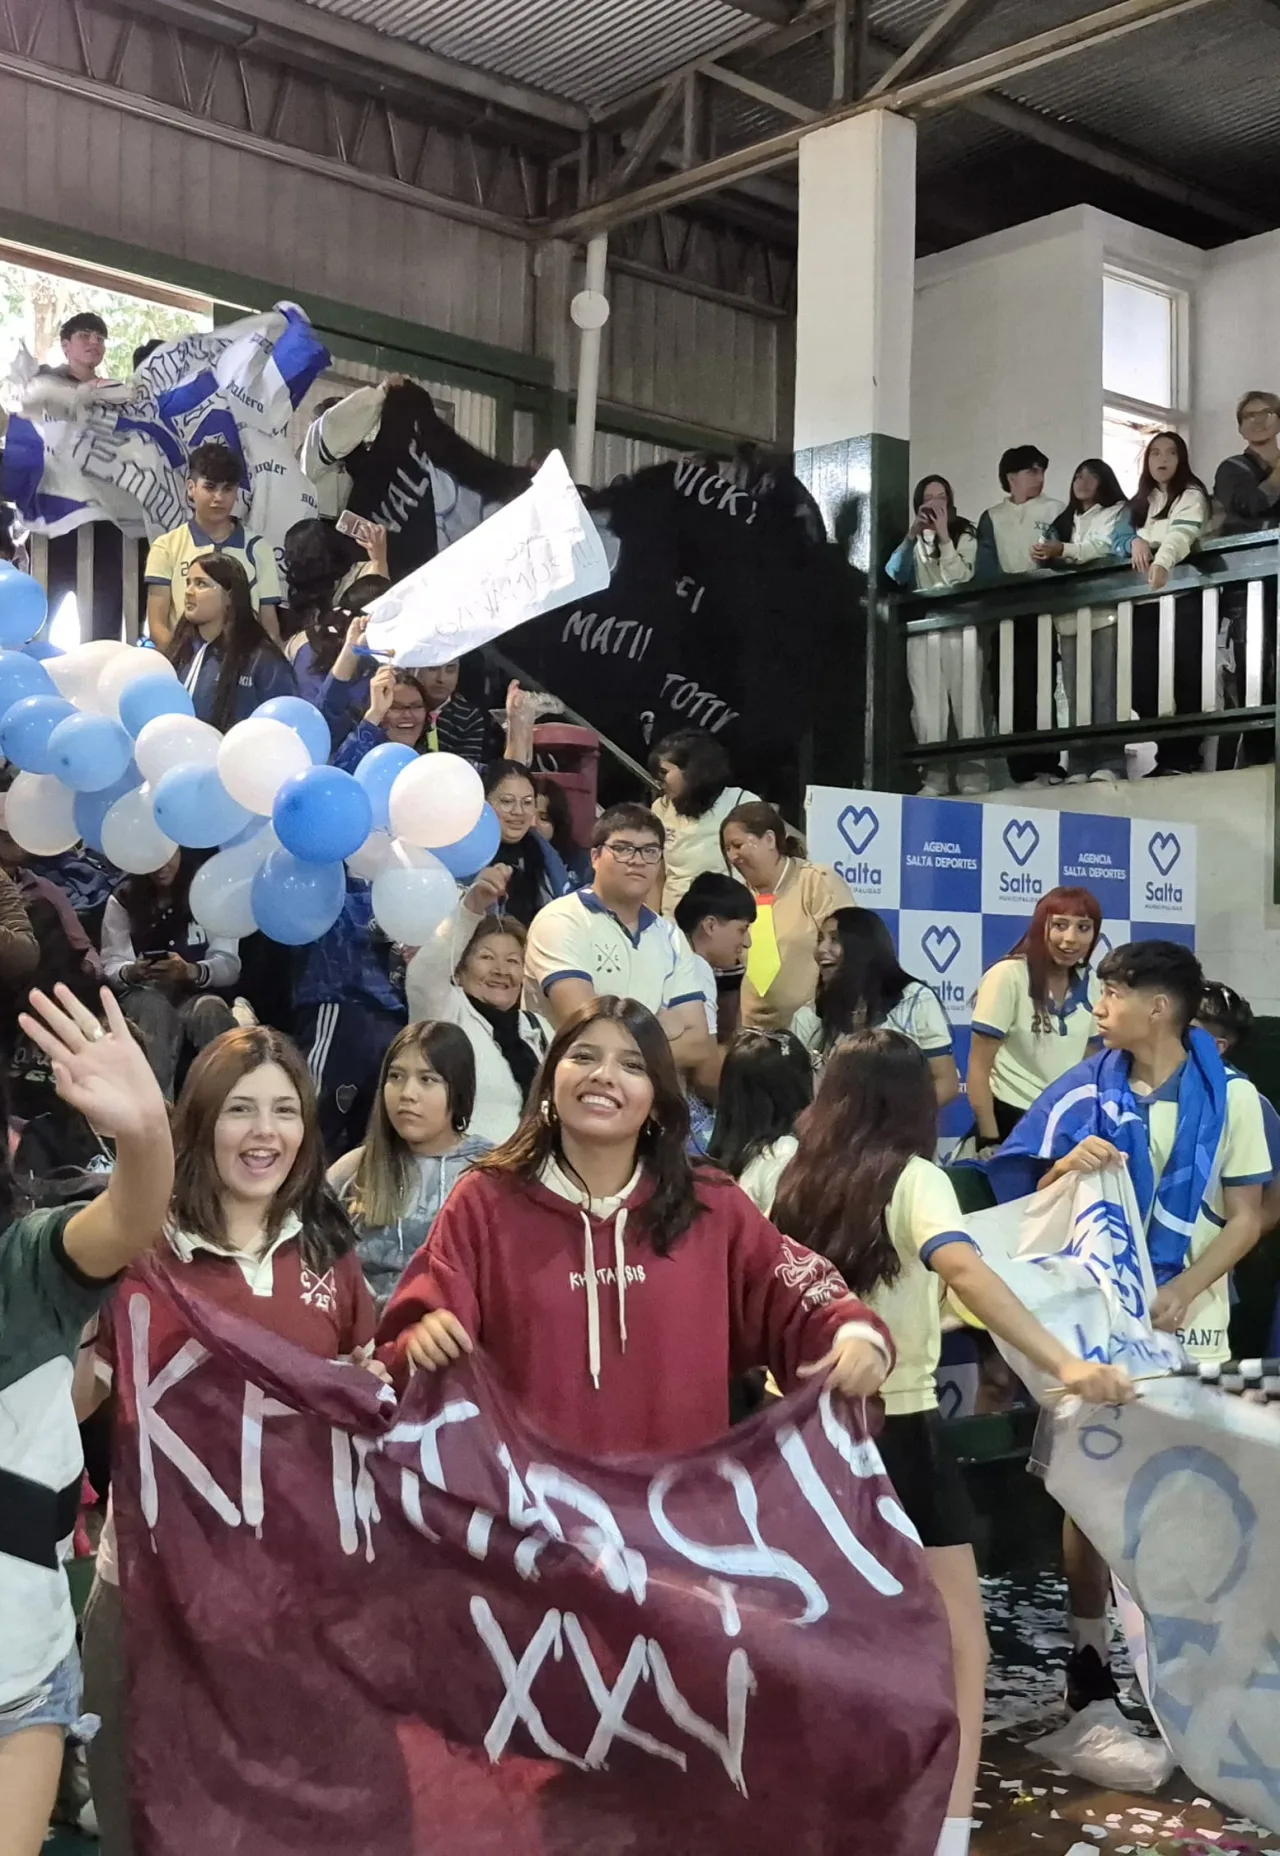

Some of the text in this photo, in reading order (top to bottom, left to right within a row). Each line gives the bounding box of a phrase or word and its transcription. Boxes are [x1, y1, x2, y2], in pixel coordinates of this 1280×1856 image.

[923, 842, 961, 854] AGENCIA
[906, 855, 977, 869] SALTA DEPORTES
[1078, 853, 1112, 865] AGENCIA
[833, 861, 882, 885] Salta
[1063, 865, 1126, 879] SALTA DEPORTES
[999, 872, 1042, 894] Salta
[1145, 881, 1183, 902] Salta
[931, 980, 965, 1002] alta
[569, 1264, 647, 1292] KHTASIS
